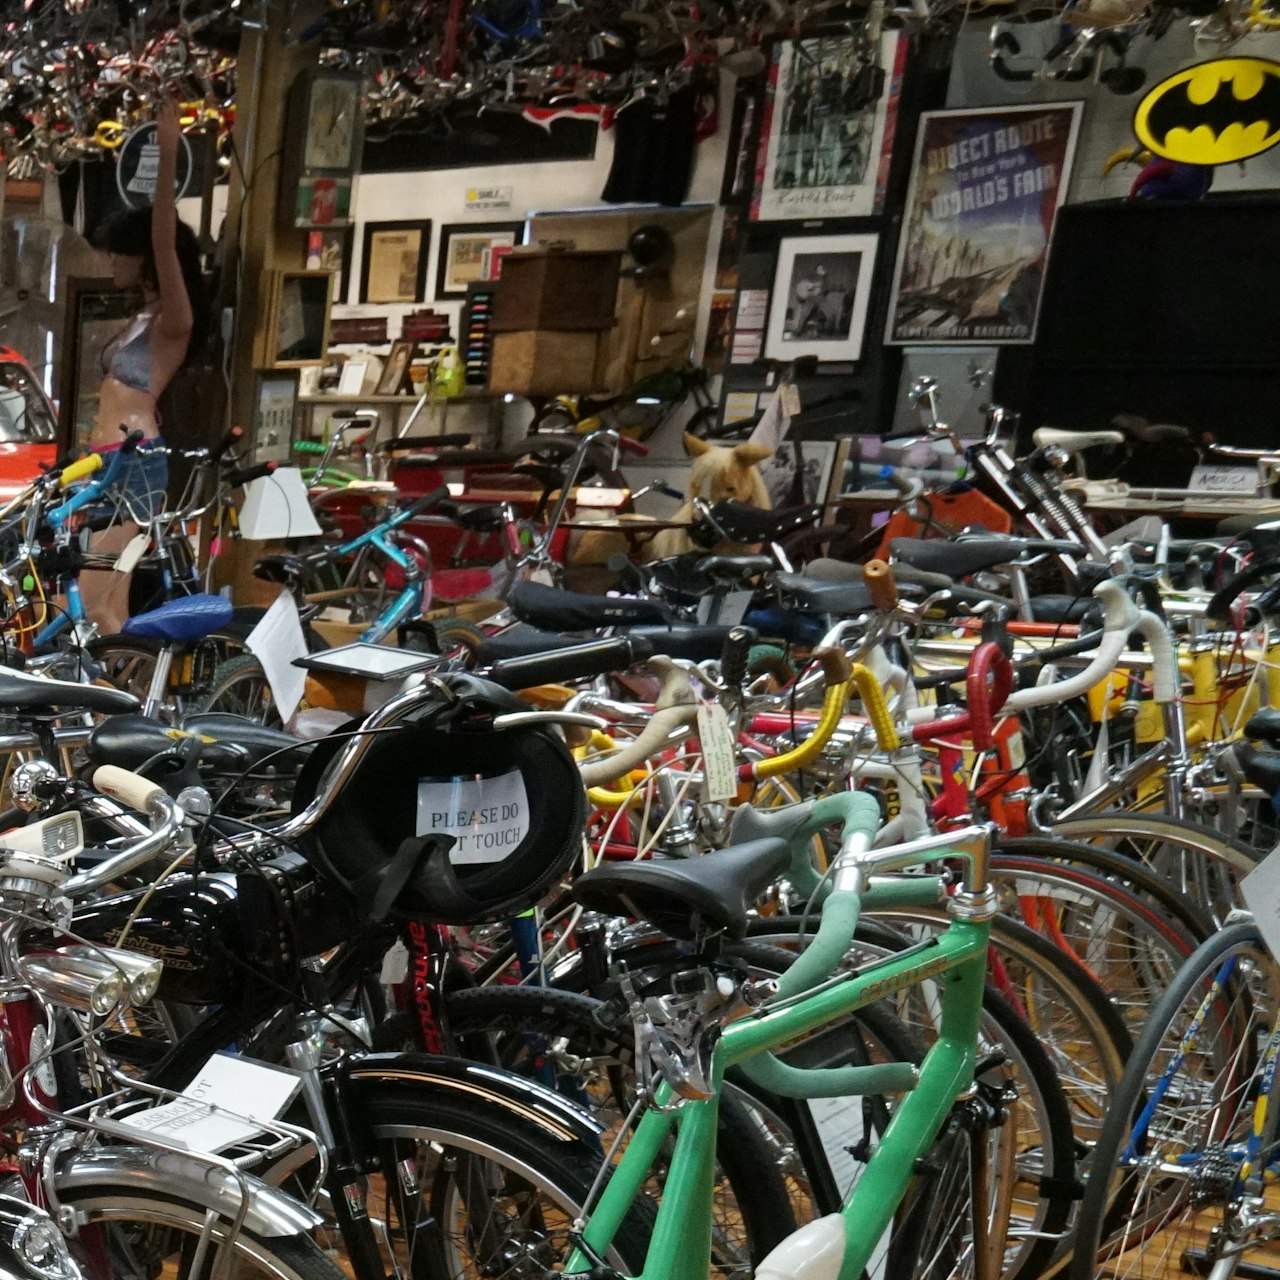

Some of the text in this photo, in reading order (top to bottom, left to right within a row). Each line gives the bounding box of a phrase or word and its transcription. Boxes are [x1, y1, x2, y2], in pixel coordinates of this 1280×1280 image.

[927, 115, 1056, 175] DIRECT ROUTE
[929, 173, 1009, 220] WORLD'S
[431, 802, 519, 829] PLEASE DO
[472, 826, 521, 850] TOUCH
[168, 1106, 188, 1120] DO
